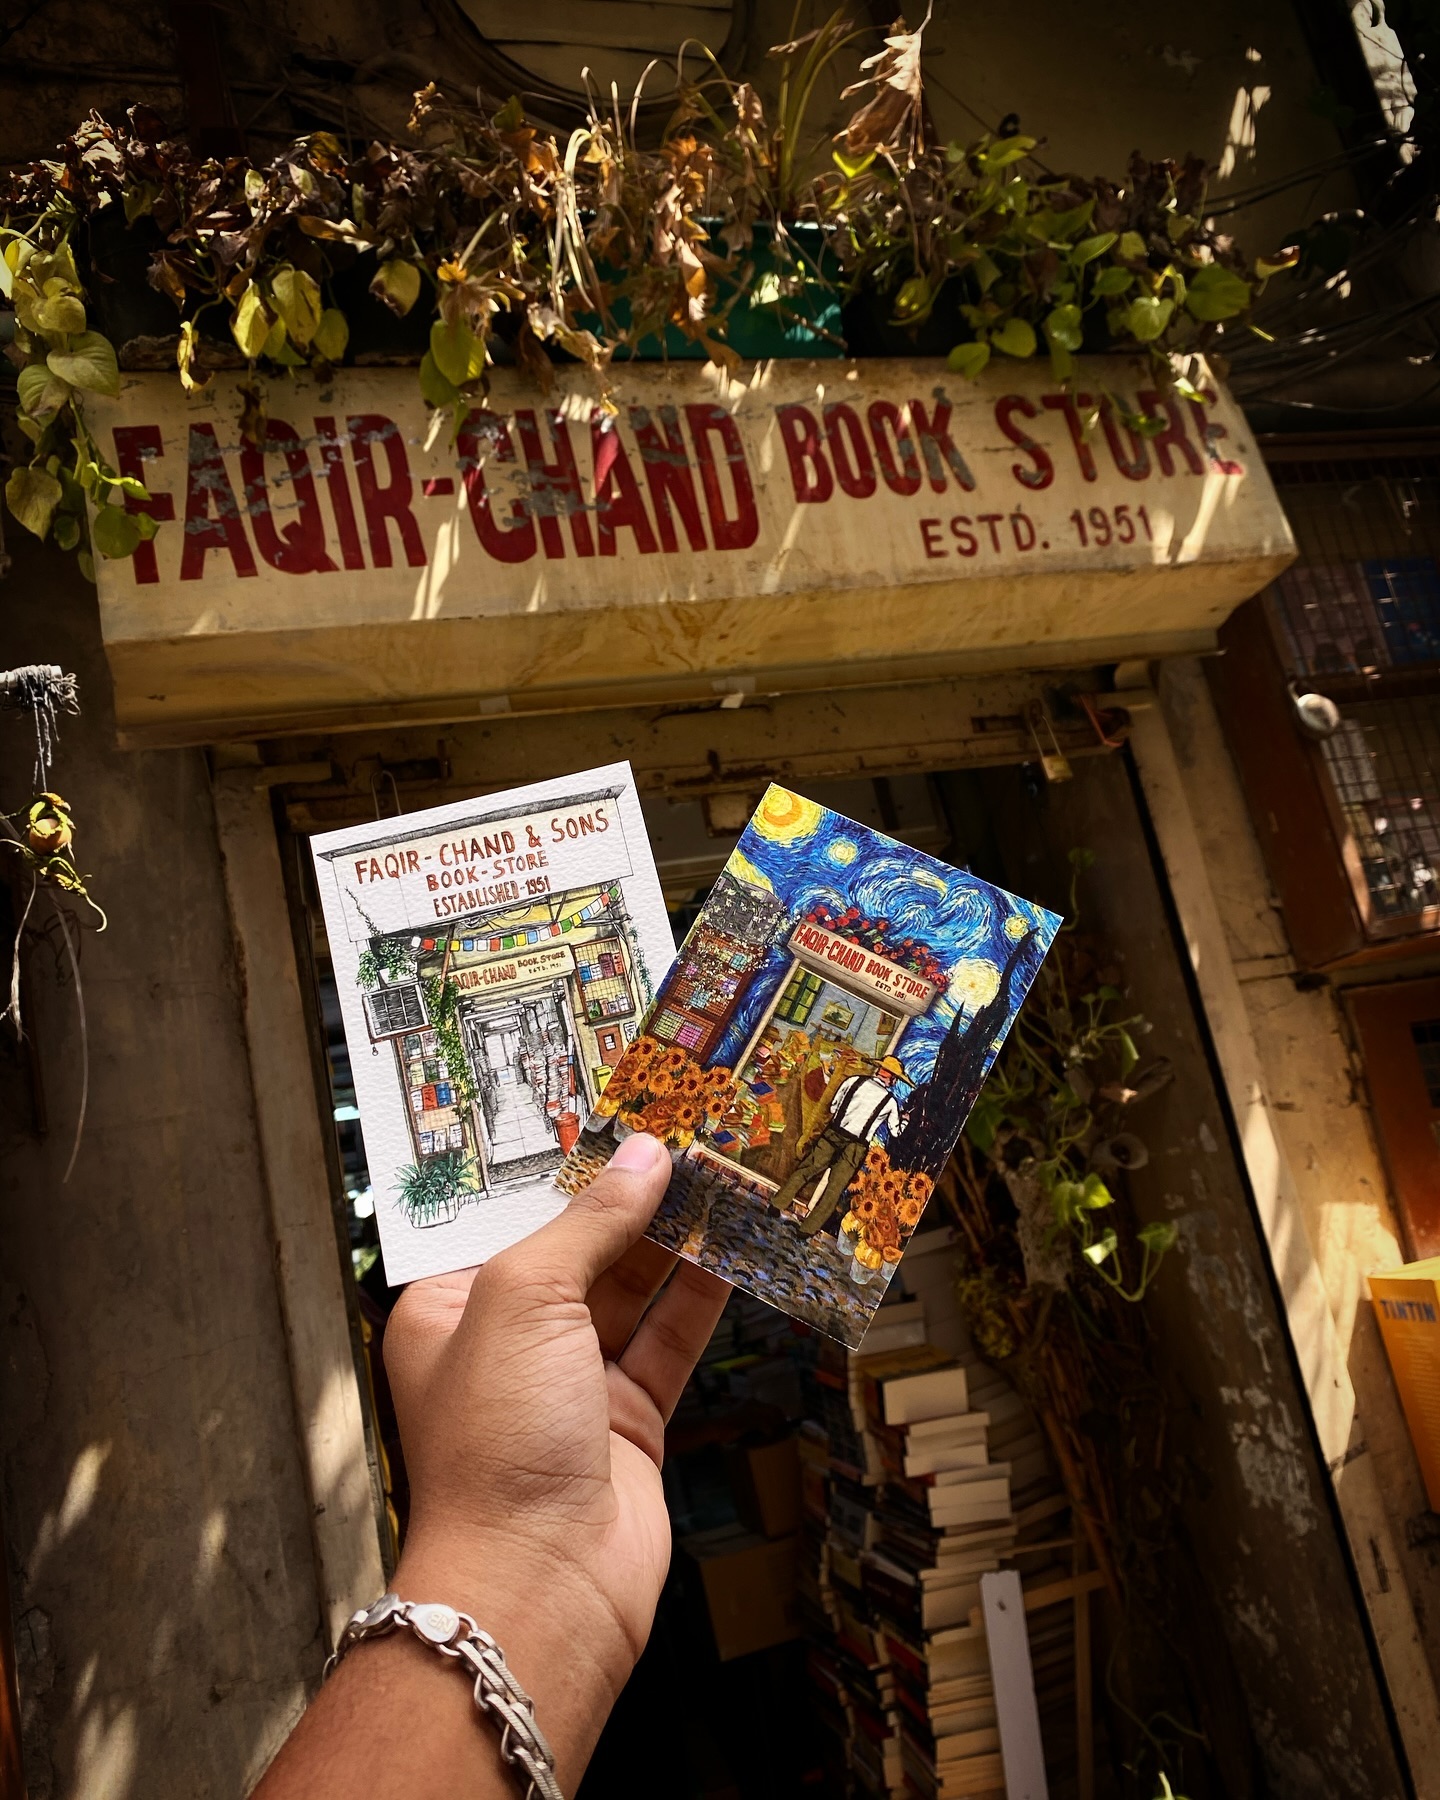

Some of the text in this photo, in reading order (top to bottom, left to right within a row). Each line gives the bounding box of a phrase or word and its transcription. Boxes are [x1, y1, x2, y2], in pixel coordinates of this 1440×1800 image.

[112, 388, 1244, 584] FAQIR-CHAND BOOK STORE
[920, 504, 1154, 560] ESTD. 1951
[526, 824, 543, 848] &
[550, 807, 610, 843] SONS
[517, 957, 539, 968] BOOK
[793, 923, 931, 1001] FAQIR-CHAND BOOK STORE
[1379, 1299, 1437, 1323] TINTIN
